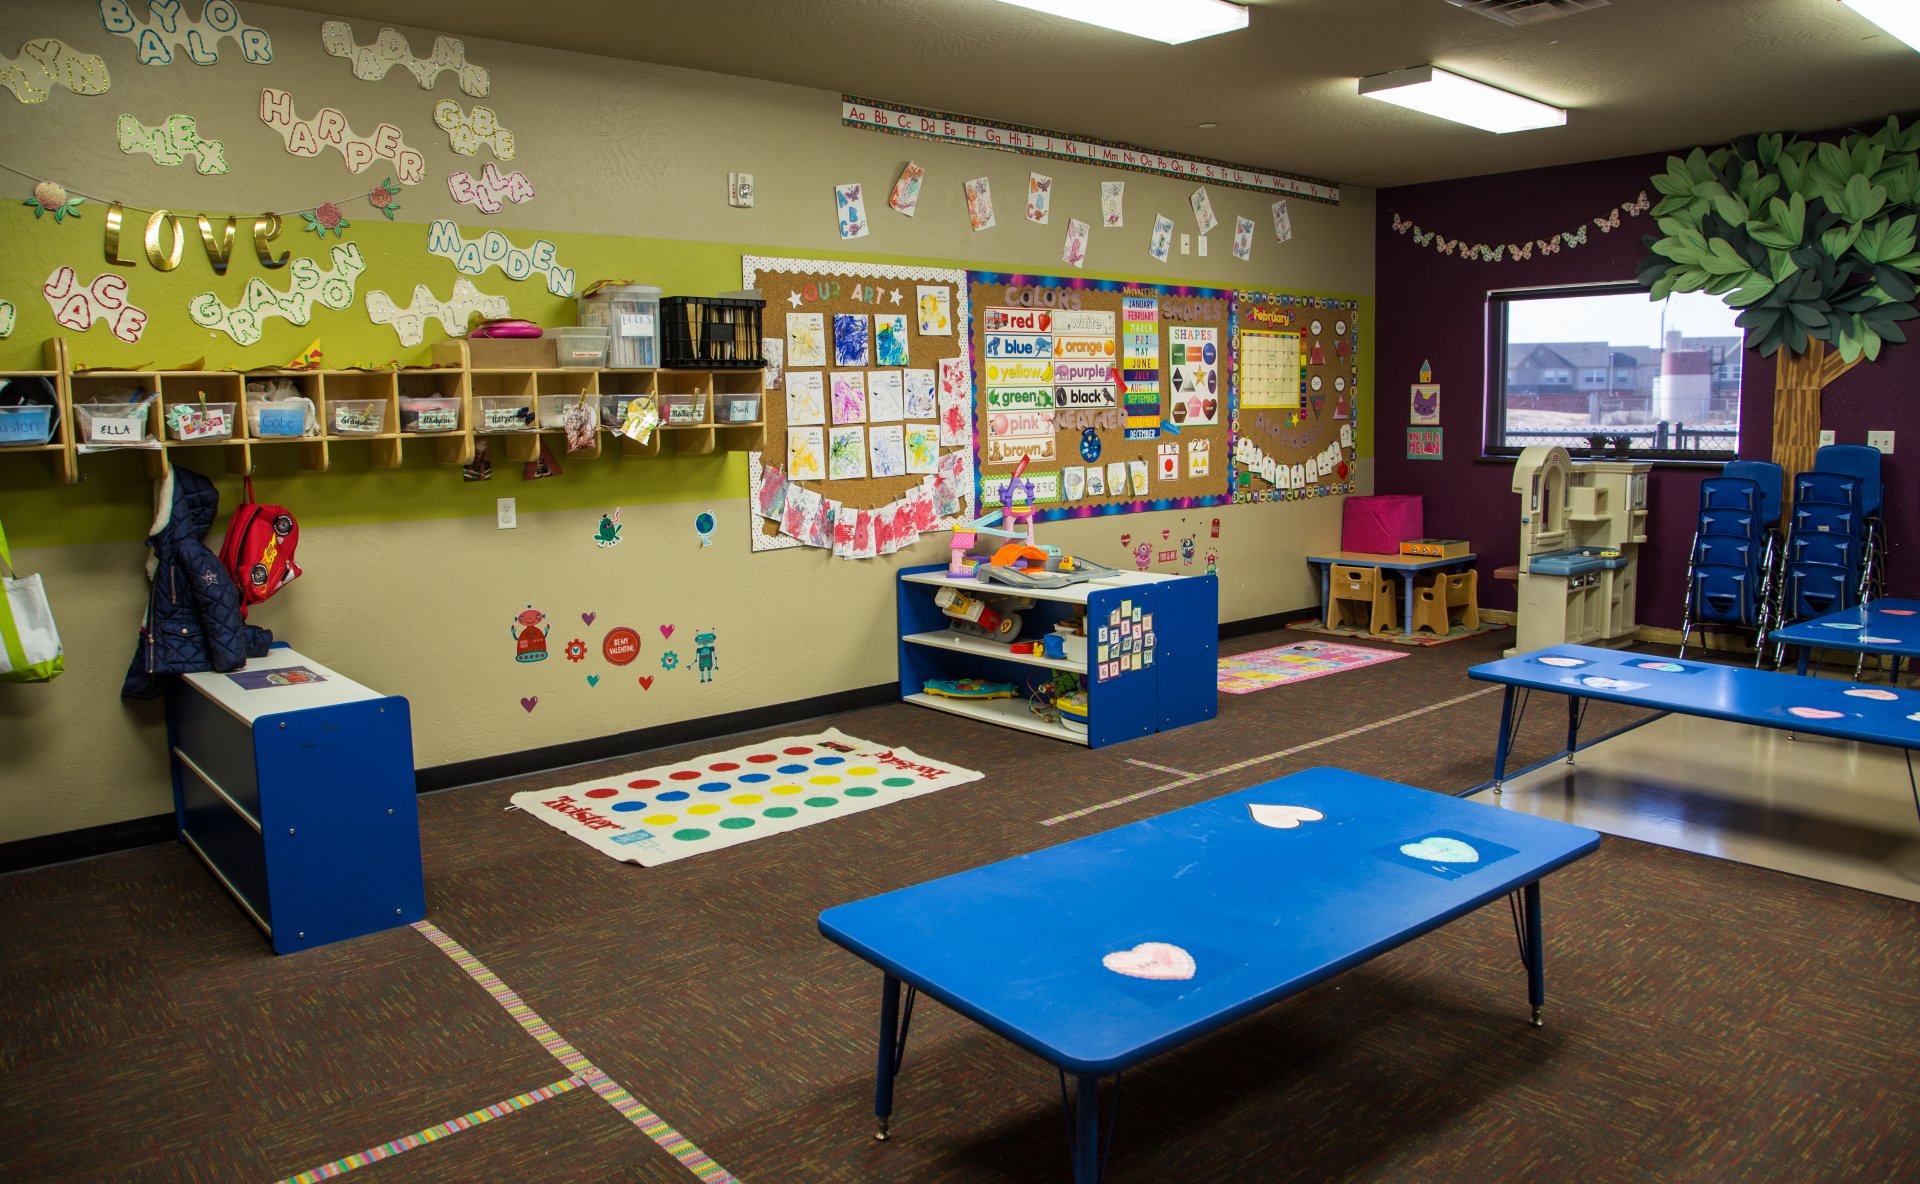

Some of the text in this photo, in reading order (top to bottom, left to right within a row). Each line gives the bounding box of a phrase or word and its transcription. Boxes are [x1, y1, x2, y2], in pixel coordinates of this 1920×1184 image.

[99, 0, 272, 64] BAYLOR
[0, 40, 108, 102] LYN
[262, 90, 424, 184] HARPER
[436, 101, 516, 158] GABE
[118, 114, 229, 174] ALEX
[850, 106, 1336, 199] Aa Bb Cc Dd Ee Ff Gg Hh Ii Jj Kk Ll Mm Nn Oo Pp Qq Rr Ss Tt Uu Vv Ww Xx Yy Zz
[450, 163, 534, 212] ELLA
[104, 202, 290, 275] LOVE
[429, 220, 575, 296] MADDEN
[190, 242, 366, 343] GRAYSON
[803, 281, 885, 304] OUR ART
[1005, 286, 1082, 311] COLORS
[45, 267, 147, 342] JACE
[1129, 300, 1153, 309] JANUARY
[1162, 301, 1221, 321] SHAPES
[1011, 313, 1034, 329] red
[1071, 316, 1101, 330] white
[1128, 311, 1154, 320] FEBRUARY
[1253, 308, 1290, 327] February
[1130, 323, 1153, 333] MARCH
[1175, 329, 1212, 340] SHAPES
[1005, 338, 1033, 354] blue
[1066, 341, 1102, 356] orange
[1136, 347, 1148, 356] MAY
[1133, 359, 1151, 368] JUNE
[1001, 362, 1041, 382] yellow
[1069, 363, 1105, 381] purple
[1135, 371, 1149, 380] JULY
[1131, 382, 1153, 392] AUGUST
[1002, 391, 1037, 406] green
[1071, 389, 1101, 403] black
[1128, 394, 1157, 404] SEPTEMBER
[263, 415, 295, 429] Gabe
[1010, 415, 1039, 433] pink
[1053, 408, 1128, 432] WEATHER
[100, 425, 130, 435] ELLA
[1130, 429, 1156, 439] DECEMBER
[1409, 432, 1440, 441] ONE IN A
[1003, 443, 1040, 457] brown
[1192, 440, 1198, 451] 2
[609, 645, 634, 654] VALENTINE
[541, 795, 622, 830] Twister
